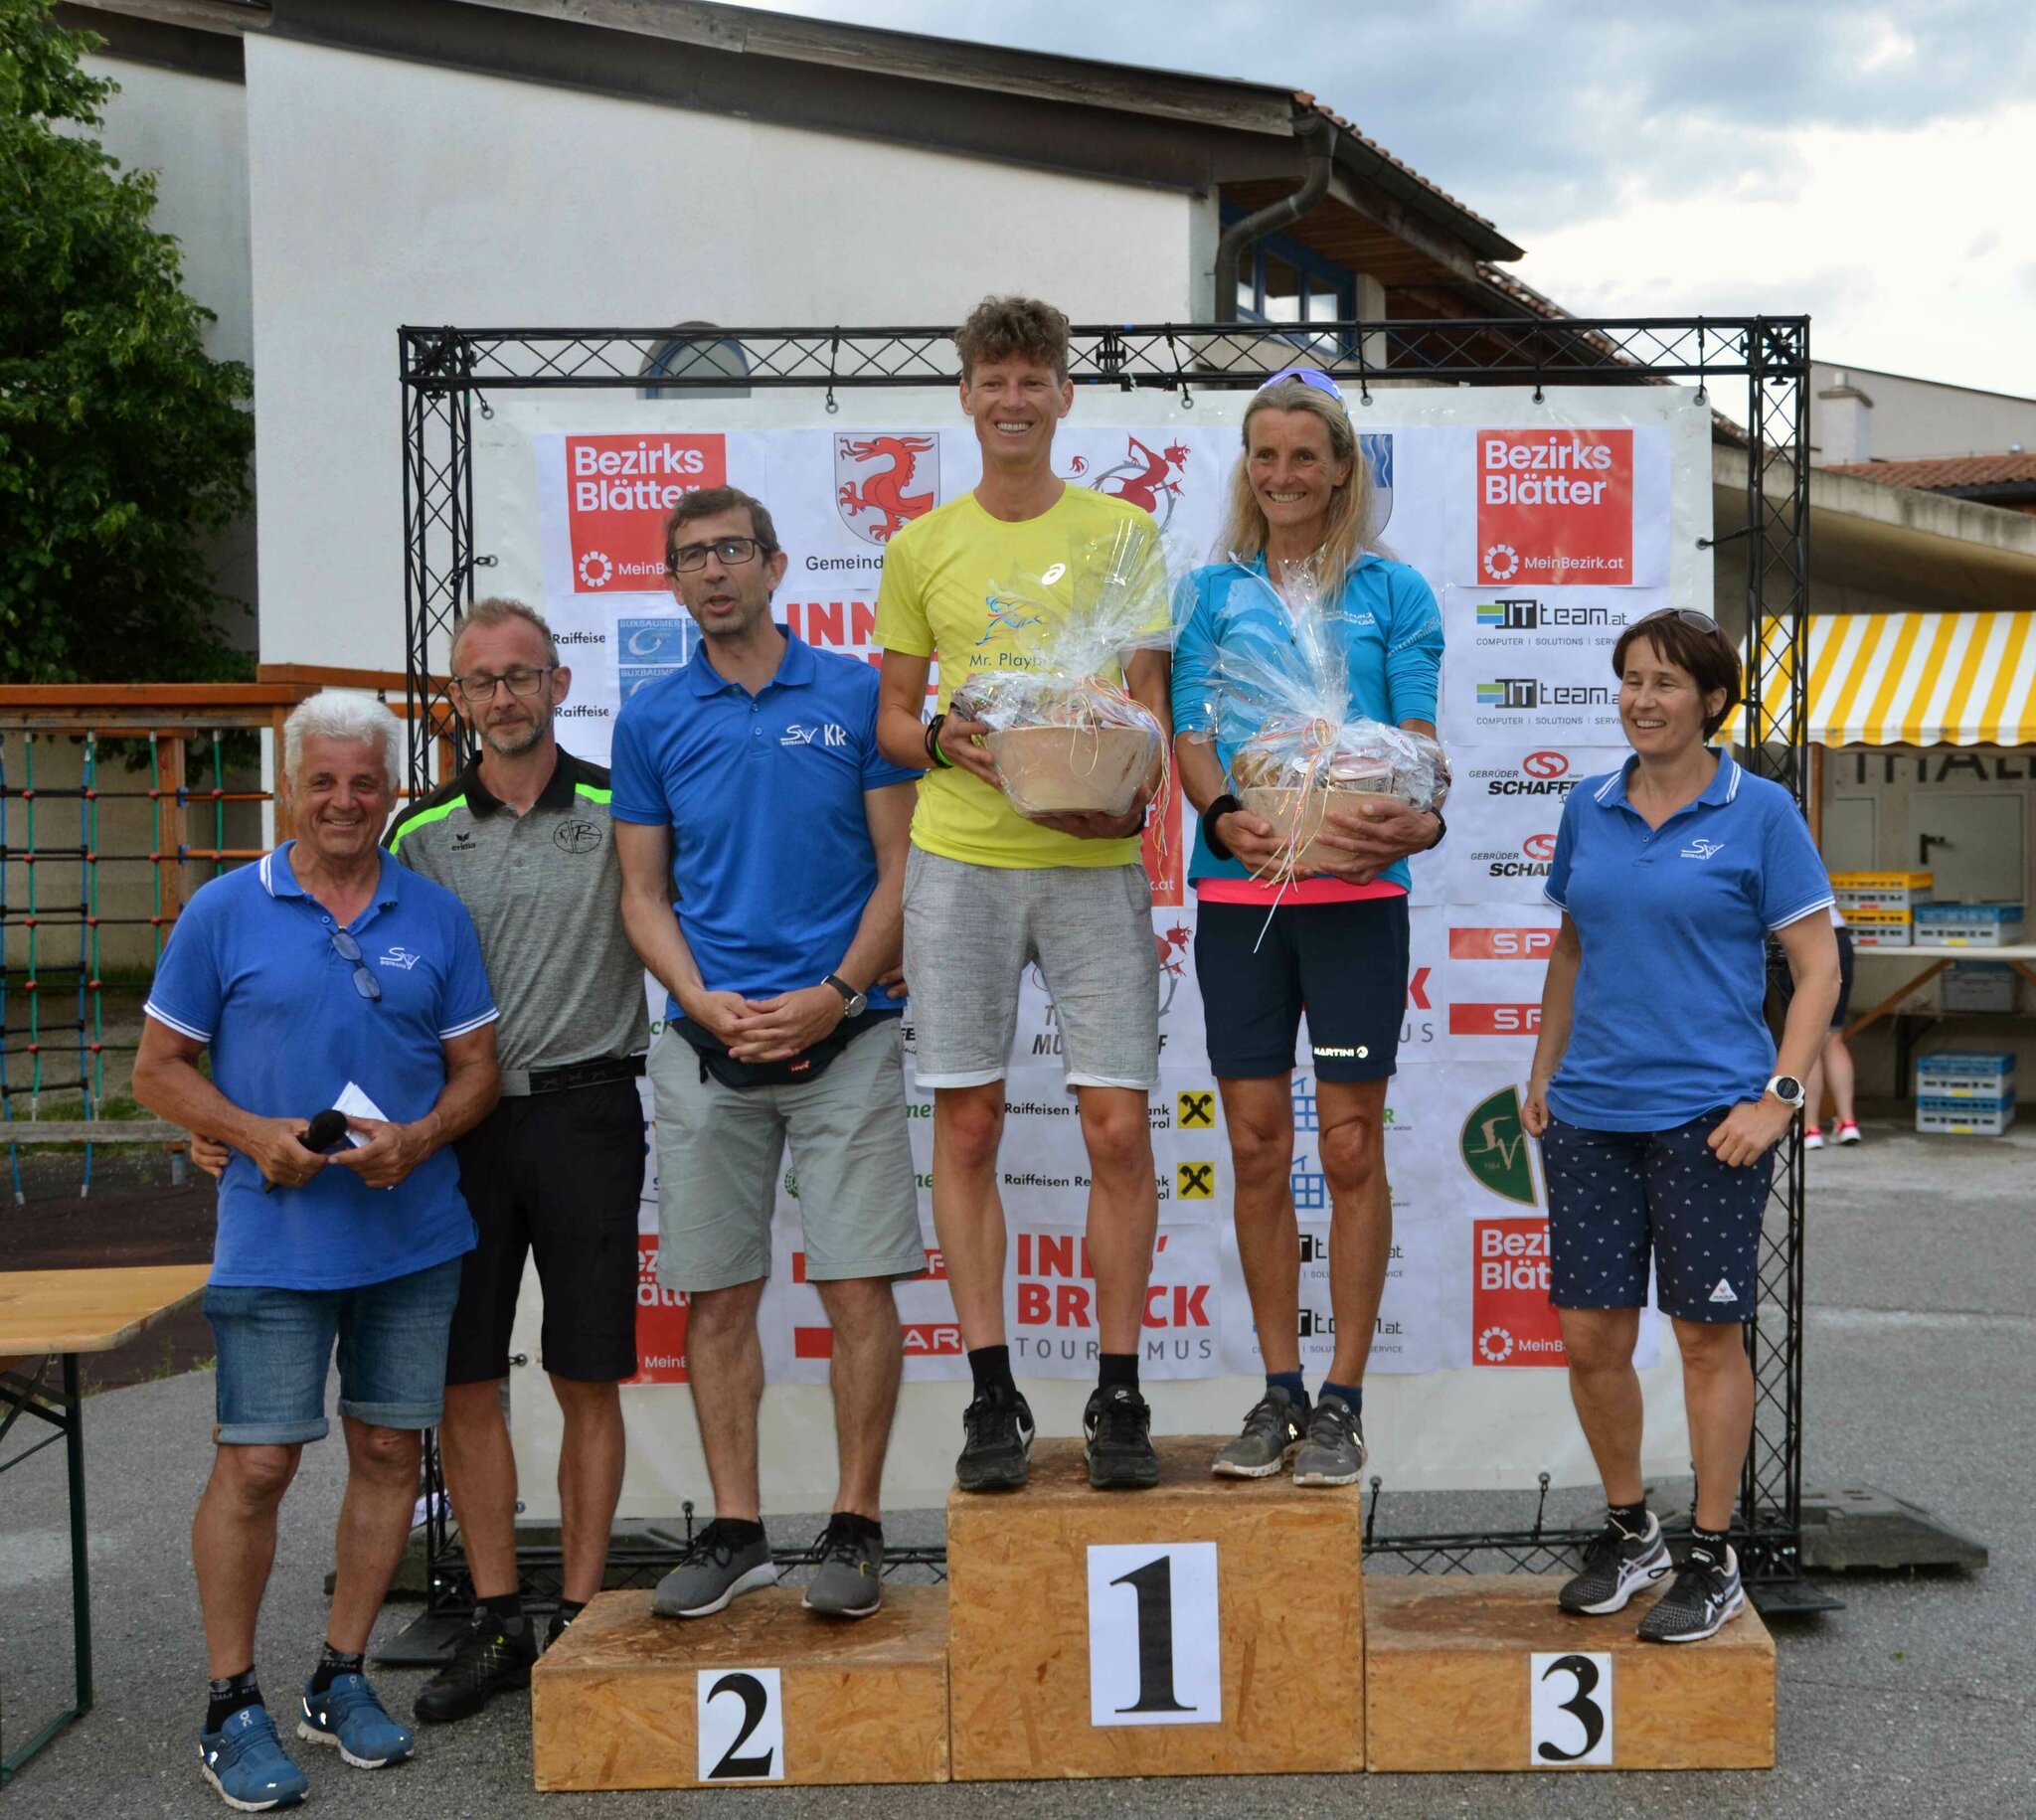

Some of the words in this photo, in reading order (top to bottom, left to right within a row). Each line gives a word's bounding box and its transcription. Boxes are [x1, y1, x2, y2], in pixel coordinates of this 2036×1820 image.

[574, 441, 704, 476] Bezirks
[1485, 436, 1612, 470] Bezirks
[576, 479, 700, 512] Blätte
[1485, 473, 1607, 505] Blätter
[618, 562, 670, 576] MeinB
[1524, 556, 1623, 570] MeinBezirk.at
[1476, 637, 1523, 646] COMPUTER
[1536, 637, 1583, 646] SOLUTIONS
[969, 653, 991, 667] Mr.
[823, 724, 847, 745] KR
[1468, 768, 1519, 778] GEBRÜDER
[451, 842, 476, 851] erima
[1470, 851, 1519, 861] GEBRÜDER
[1313, 1047, 1355, 1058] MARTINI
[1004, 1102, 1070, 1115] Raiffeisen
[1004, 1174, 1070, 1187] Raiffeisen
[1017, 1282, 1211, 1329] BRCK
[1109, 1556, 1197, 1713] 1
[1538, 1655, 1604, 1761] 3
[706, 1673, 773, 1778] 2
